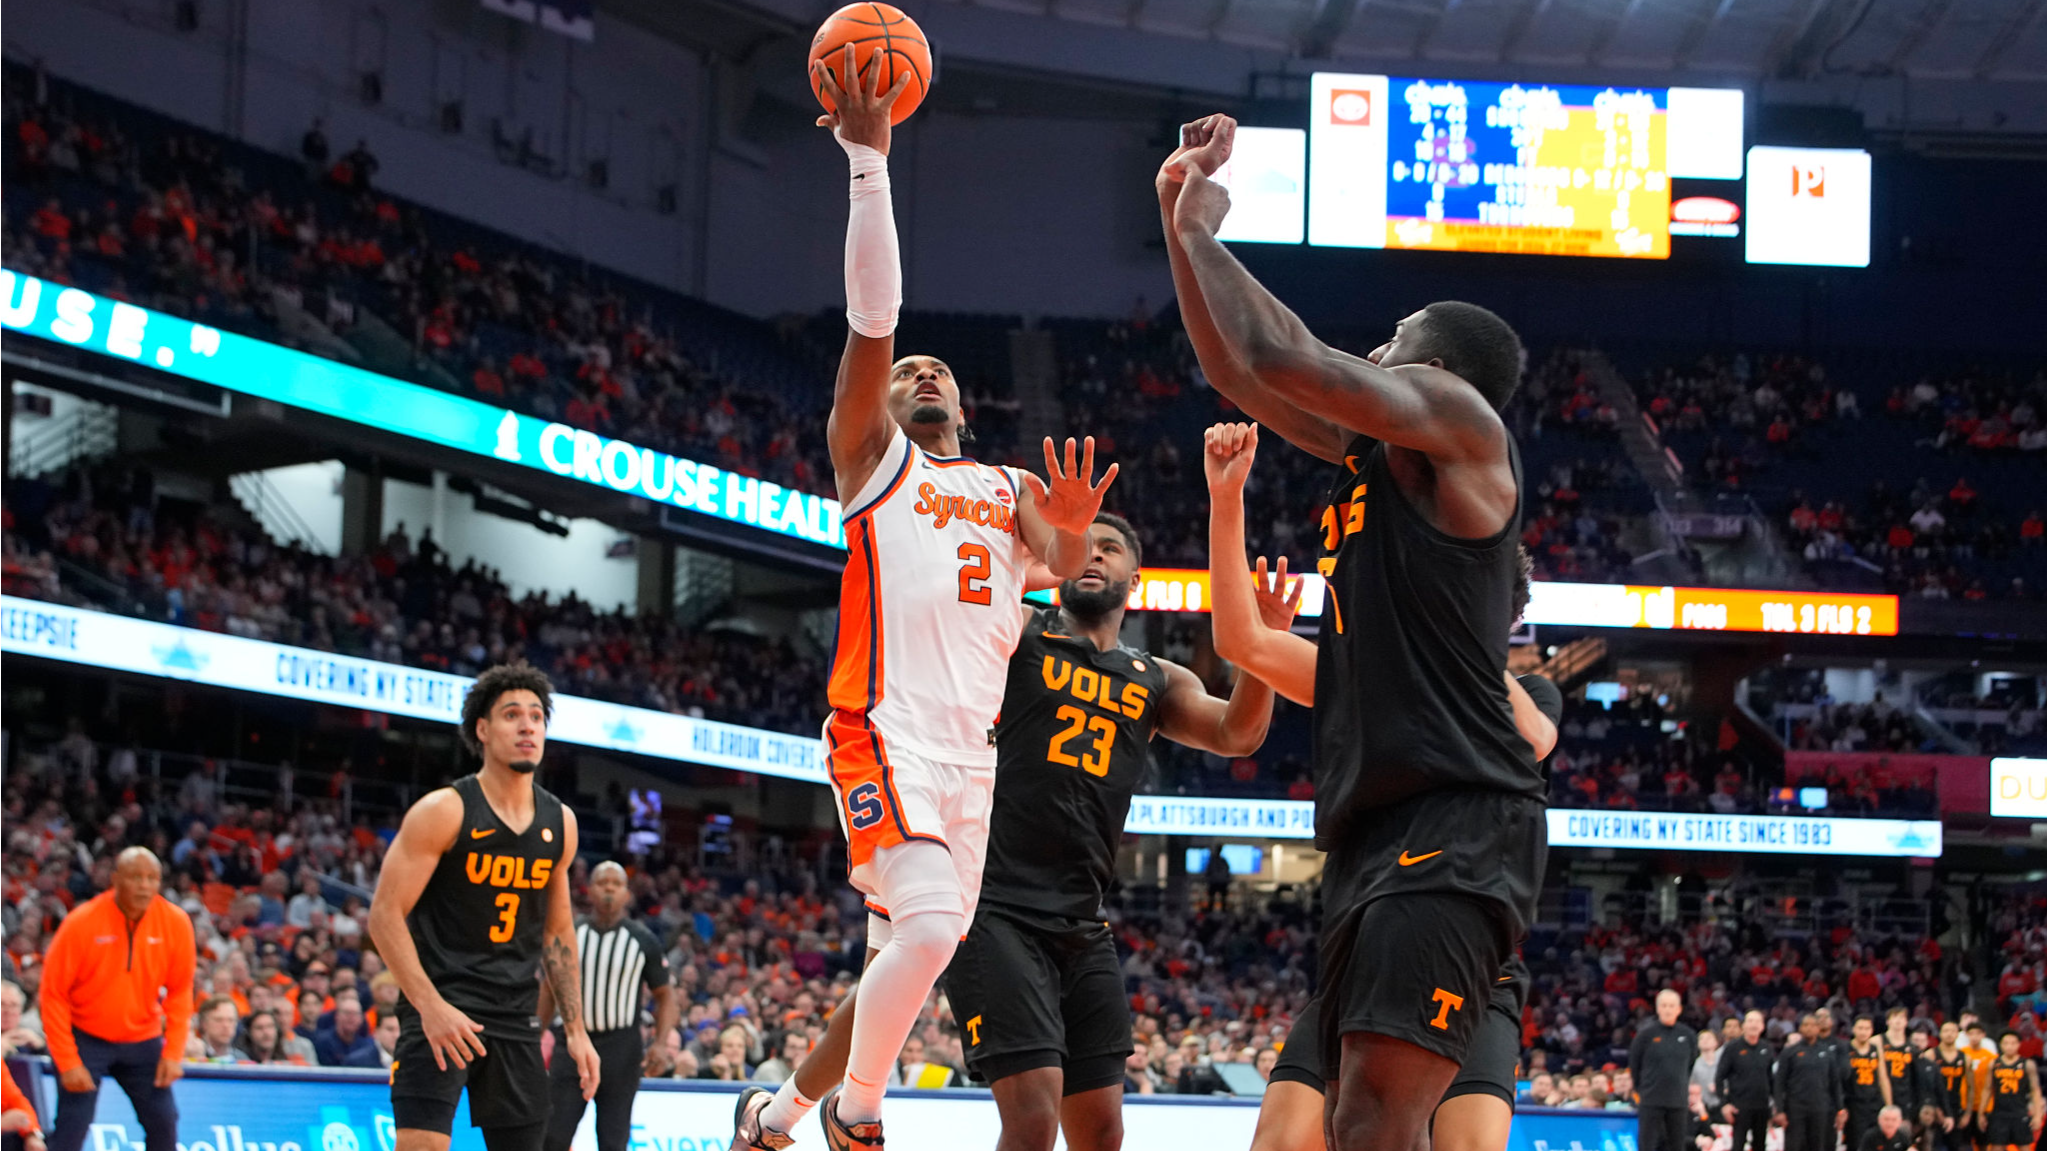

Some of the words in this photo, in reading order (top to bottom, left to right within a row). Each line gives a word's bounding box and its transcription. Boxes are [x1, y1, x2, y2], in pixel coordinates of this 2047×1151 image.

[539, 422, 720, 513] CROUSE
[726, 472, 848, 546] HEALT
[914, 481, 1016, 537] Syracus
[957, 542, 992, 606] 2
[1856, 605, 1871, 634] 2
[277, 653, 369, 697] COVERING
[377, 670, 397, 701] NY
[405, 676, 454, 711] STATE
[1041, 655, 1149, 721] VOLS
[768, 739, 814, 770] COVERS
[1047, 704, 1117, 778] 23
[848, 781, 885, 831] S
[1140, 803, 1250, 828] PLATTSBURGH
[1256, 808, 1286, 829] AND
[1568, 815, 1652, 841] COVERING
[1657, 818, 1677, 842] NY
[1684, 820, 1733, 844] STATE
[1739, 822, 1786, 845] SINCE
[1793, 823, 1832, 846] 1983
[465, 852, 553, 889] VOLS
[489, 892, 521, 943] 3
[966, 1014, 982, 1047] T
[1430, 987, 1464, 1030] T
